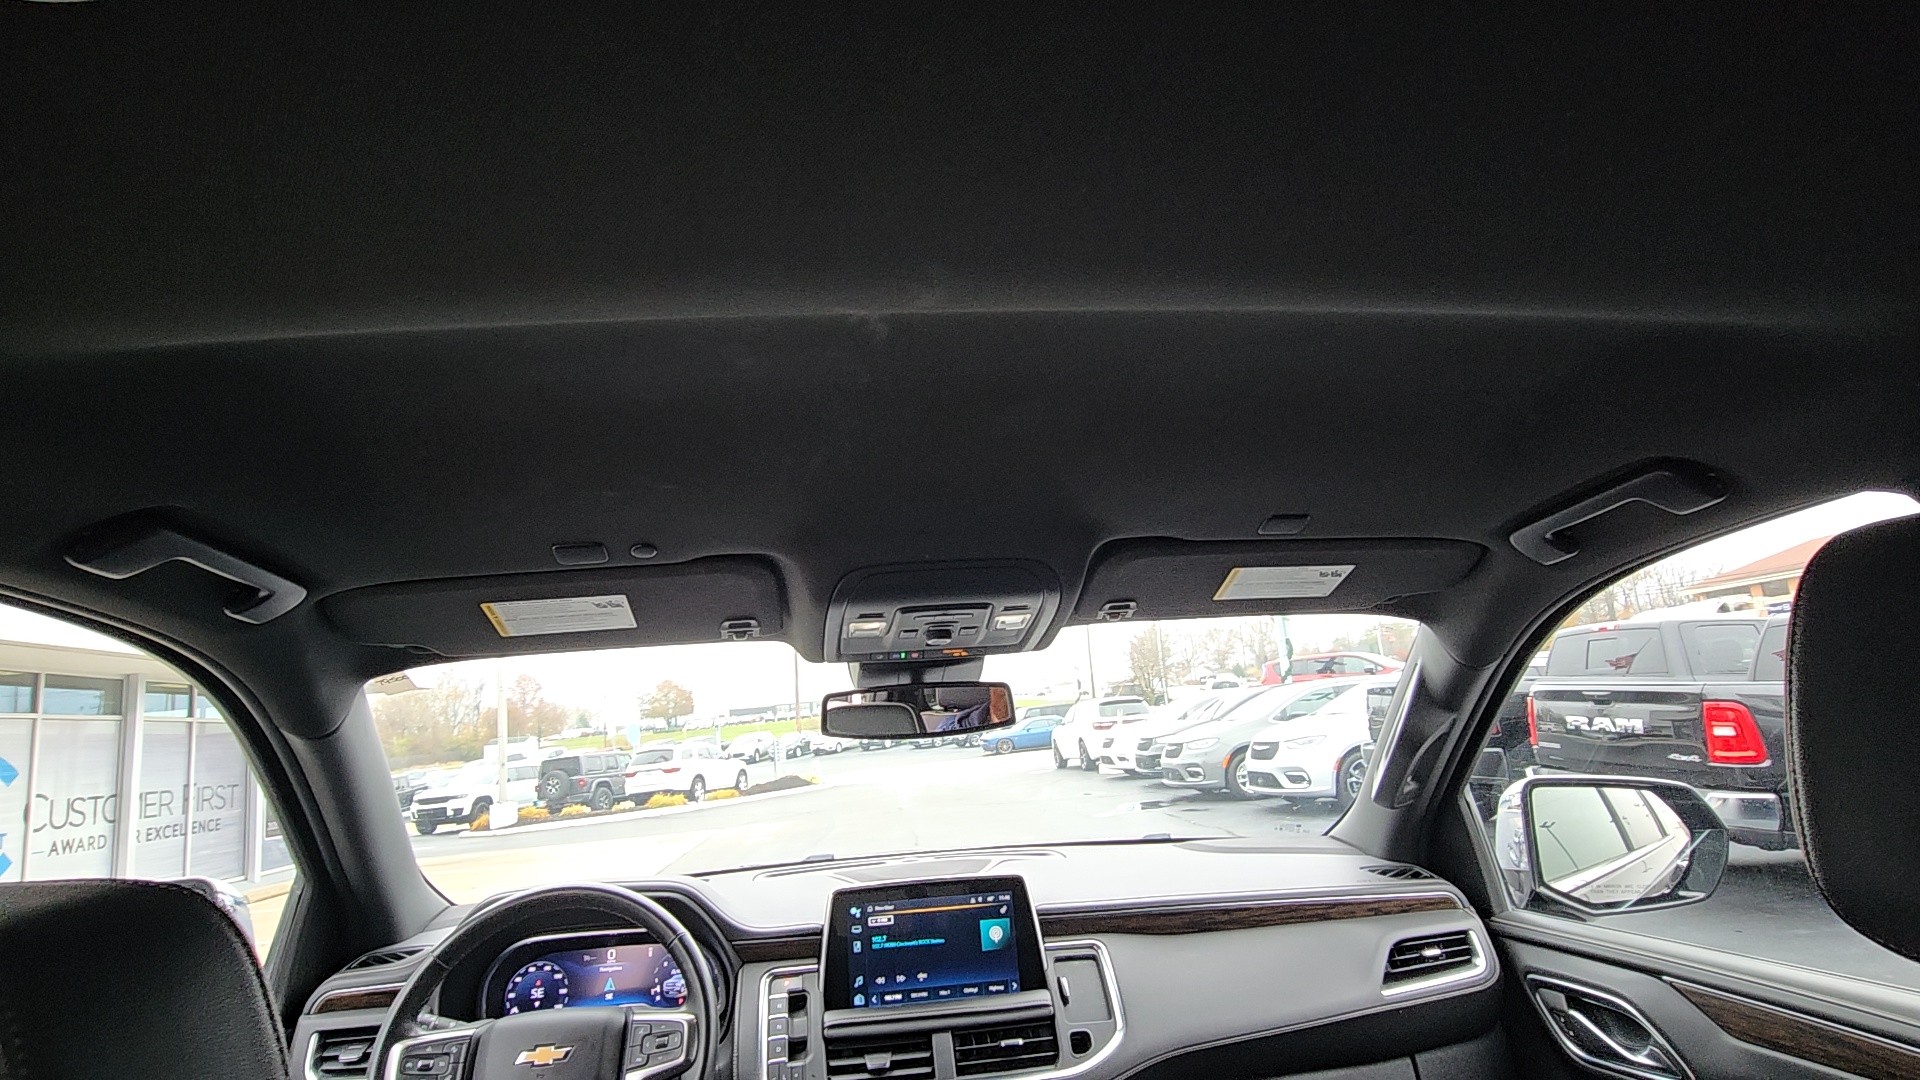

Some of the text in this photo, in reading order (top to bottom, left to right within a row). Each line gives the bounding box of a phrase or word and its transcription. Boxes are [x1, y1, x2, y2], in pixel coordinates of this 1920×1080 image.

[1565, 715, 1644, 734] RAM
[23, 782, 240, 833] CUSTOER FIRST
[48, 834, 107, 858] AWARD
[146, 817, 222, 842] EXCELENCE
[529, 987, 545, 999] SE
